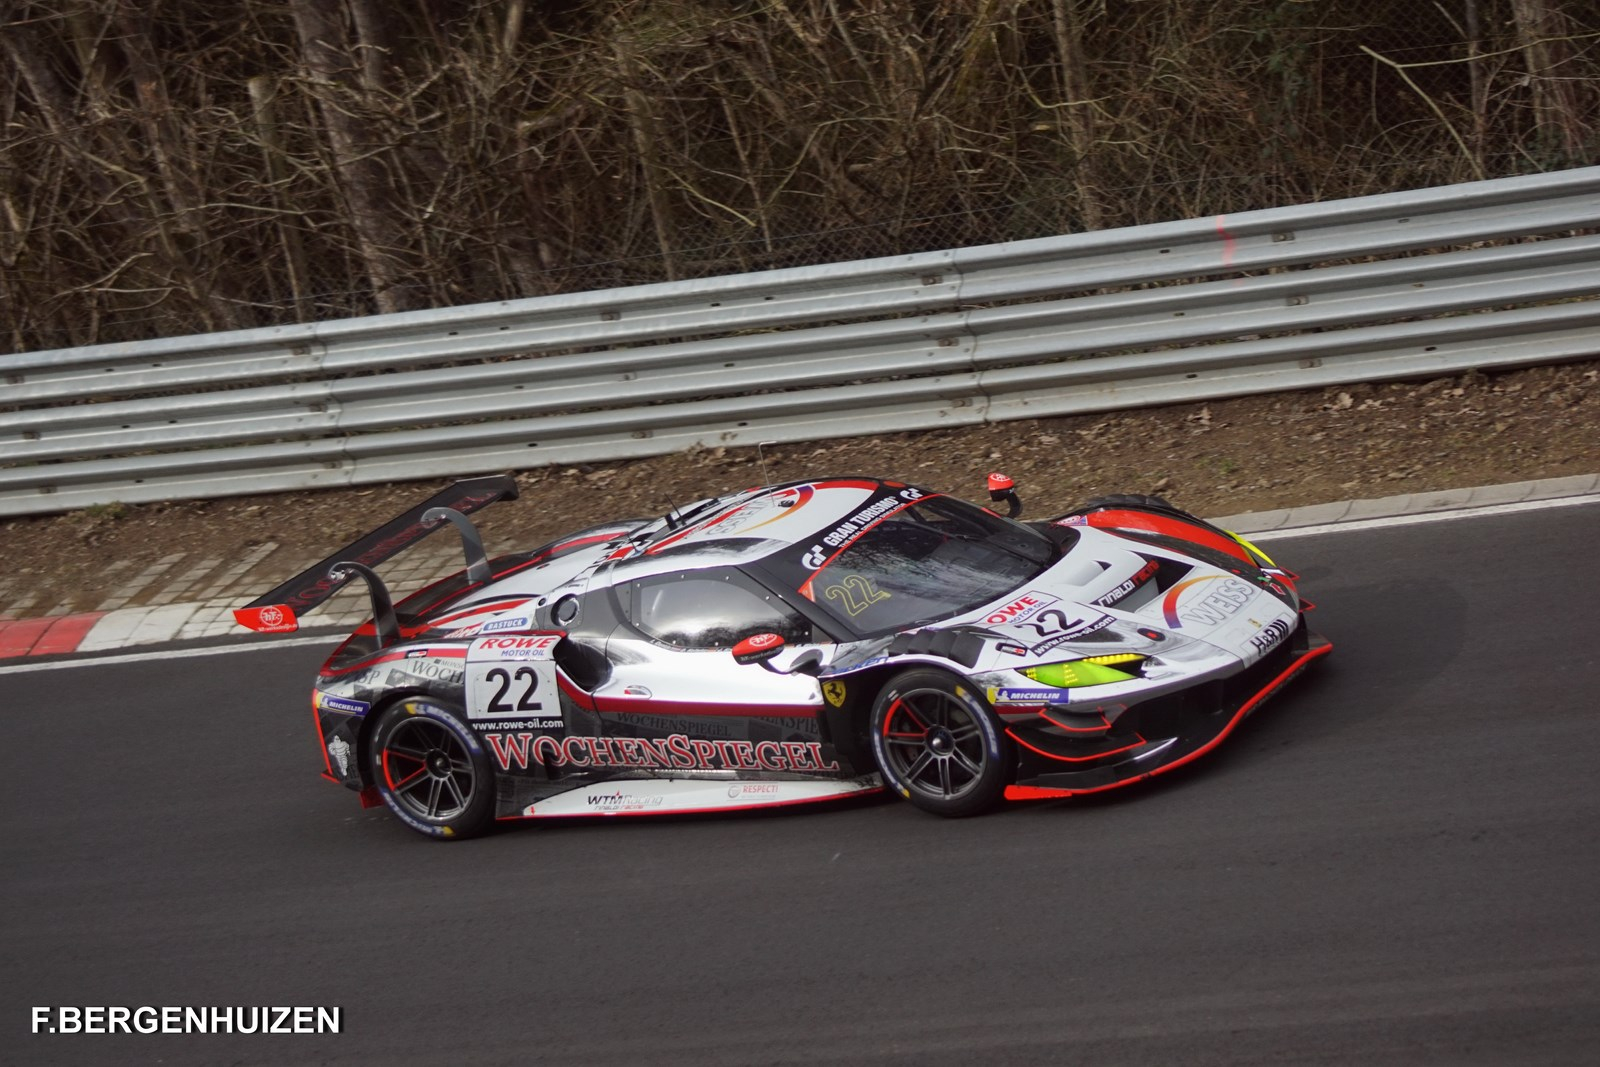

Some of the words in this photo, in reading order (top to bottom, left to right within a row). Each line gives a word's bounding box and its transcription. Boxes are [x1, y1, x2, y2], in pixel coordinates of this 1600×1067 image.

[823, 523, 858, 548] GRAN
[825, 574, 892, 616] 22
[1180, 578, 1254, 626] WEISS
[987, 596, 1039, 624] OWE
[487, 619, 523, 630] BASTUCK
[1014, 609, 1085, 637] 22
[479, 638, 557, 649] ROWE
[501, 649, 530, 657] MOTOR
[485, 666, 542, 713] 22
[1010, 692, 1061, 700] MICHELIN
[328, 701, 363, 712] MICHELIN
[472, 718, 564, 730] www.rowe-oil.com
[616, 712, 732, 737] WOCHENSPIEGEL
